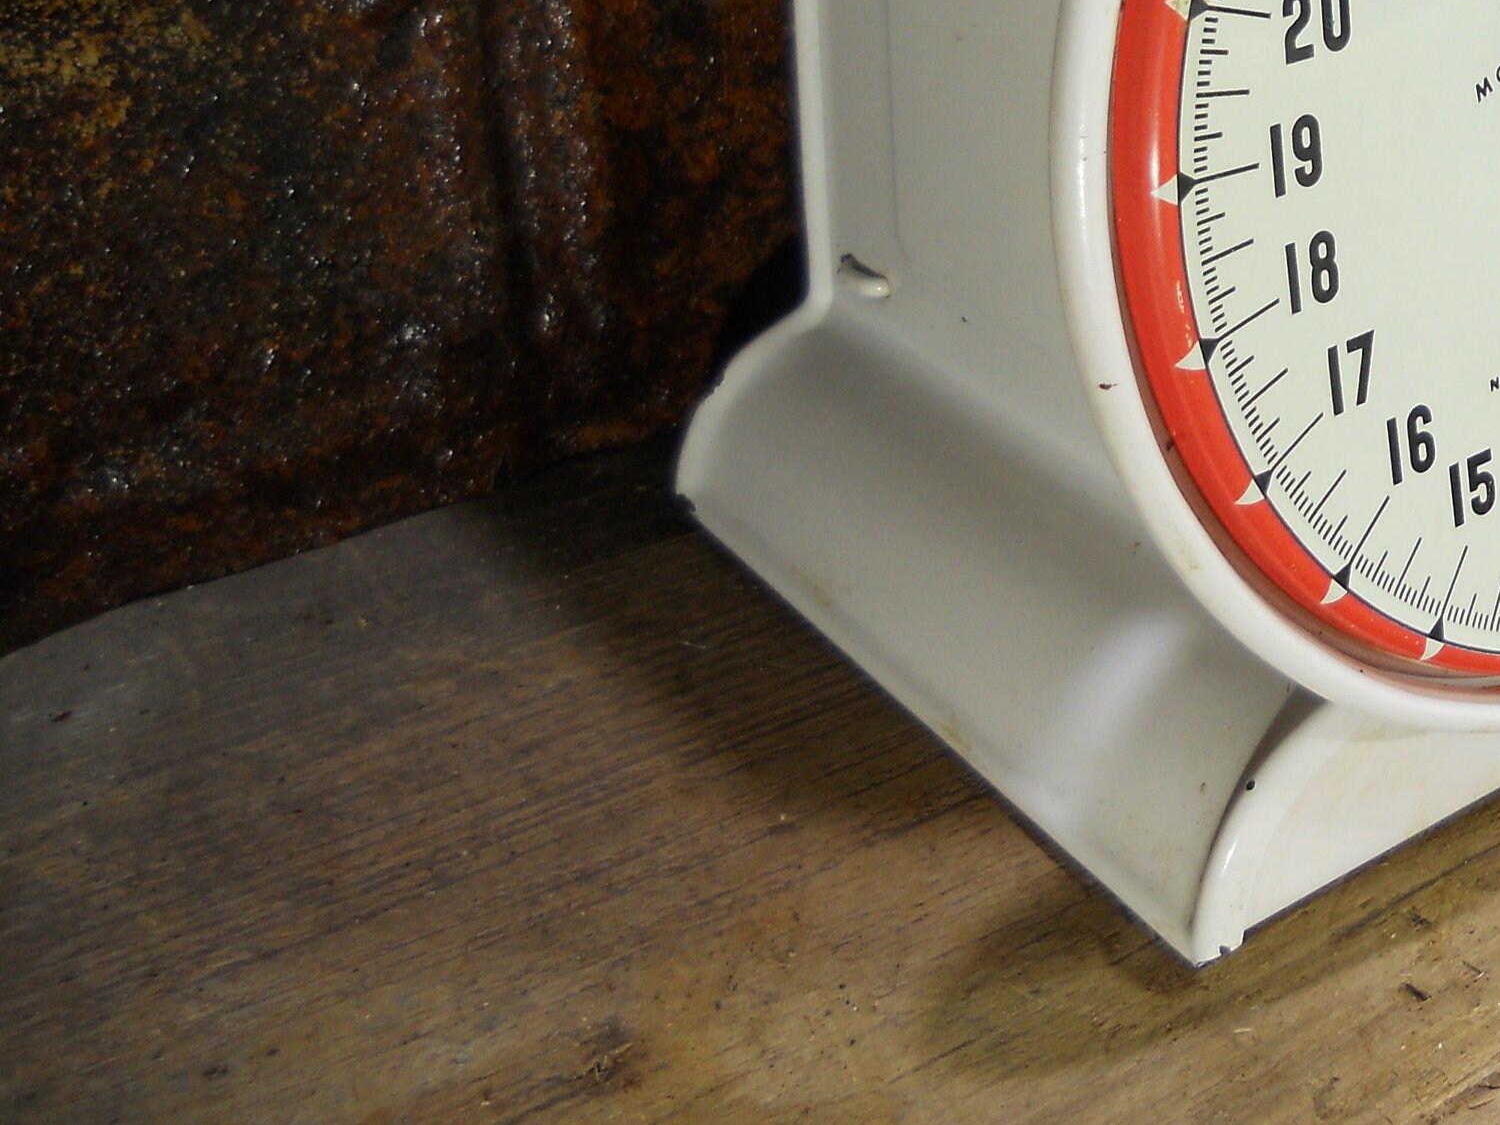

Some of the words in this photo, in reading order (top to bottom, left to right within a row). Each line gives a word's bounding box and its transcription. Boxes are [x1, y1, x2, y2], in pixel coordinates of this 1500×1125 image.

[1269, 114, 1323, 198] 19
[1285, 230, 1340, 315] 18
[1327, 330, 1375, 416] 17
[1386, 404, 1436, 486] 16
[1449, 448, 1496, 528] 15
